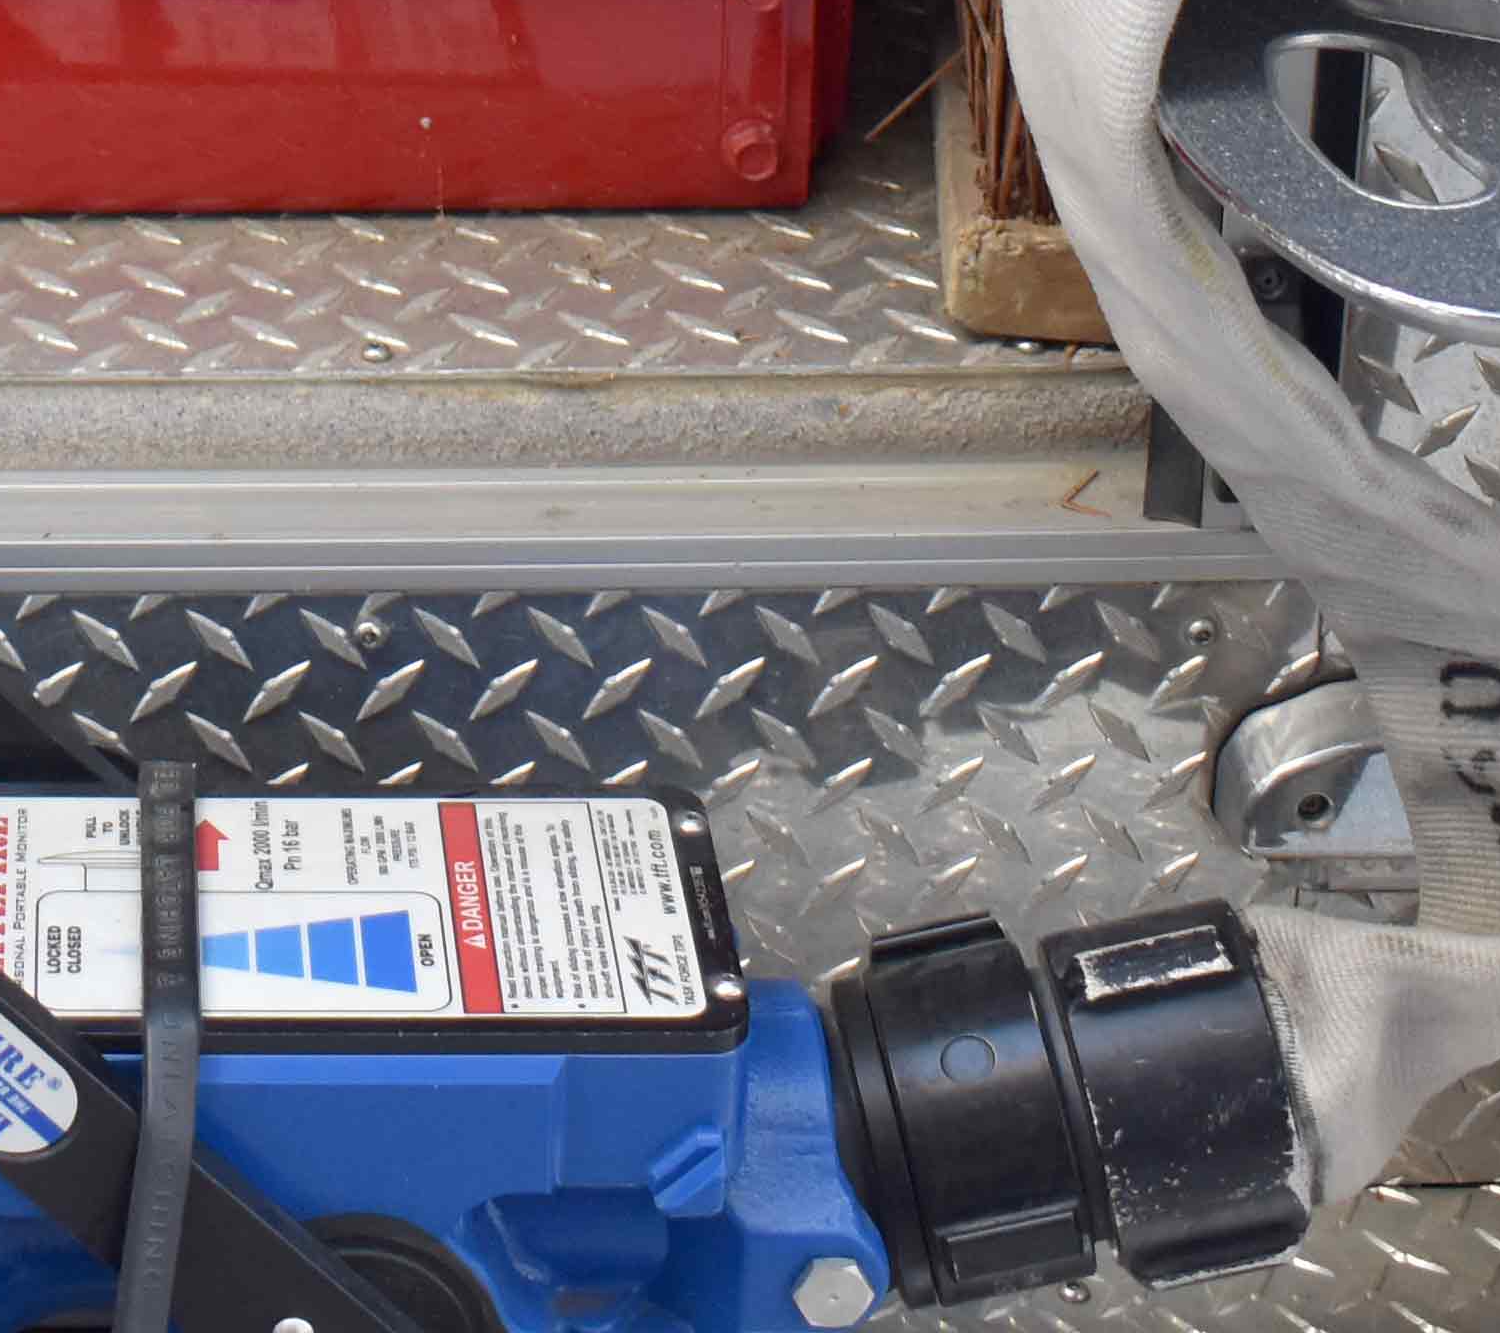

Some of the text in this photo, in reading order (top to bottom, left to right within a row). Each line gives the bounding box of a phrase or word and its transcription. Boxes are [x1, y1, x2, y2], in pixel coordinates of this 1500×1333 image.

[14, 808, 28, 862] MONITOR
[102, 821, 113, 834] TO
[119, 809, 130, 845] UNLOCK
[251, 830, 271, 855] 2000
[281, 819, 301, 871] Pn 16 bar
[255, 858, 273, 890] Qmax
[454, 861, 484, 930] DANGER
[648, 830, 677, 914] www.tft.com
[12, 868, 27, 931] PORTABLE
[46, 925, 62, 974] LOCKED
[67, 925, 82, 974] CLOSED
[417, 933, 434, 967] OPEN
[672, 935, 696, 1005] TASK FORCE TIPS
